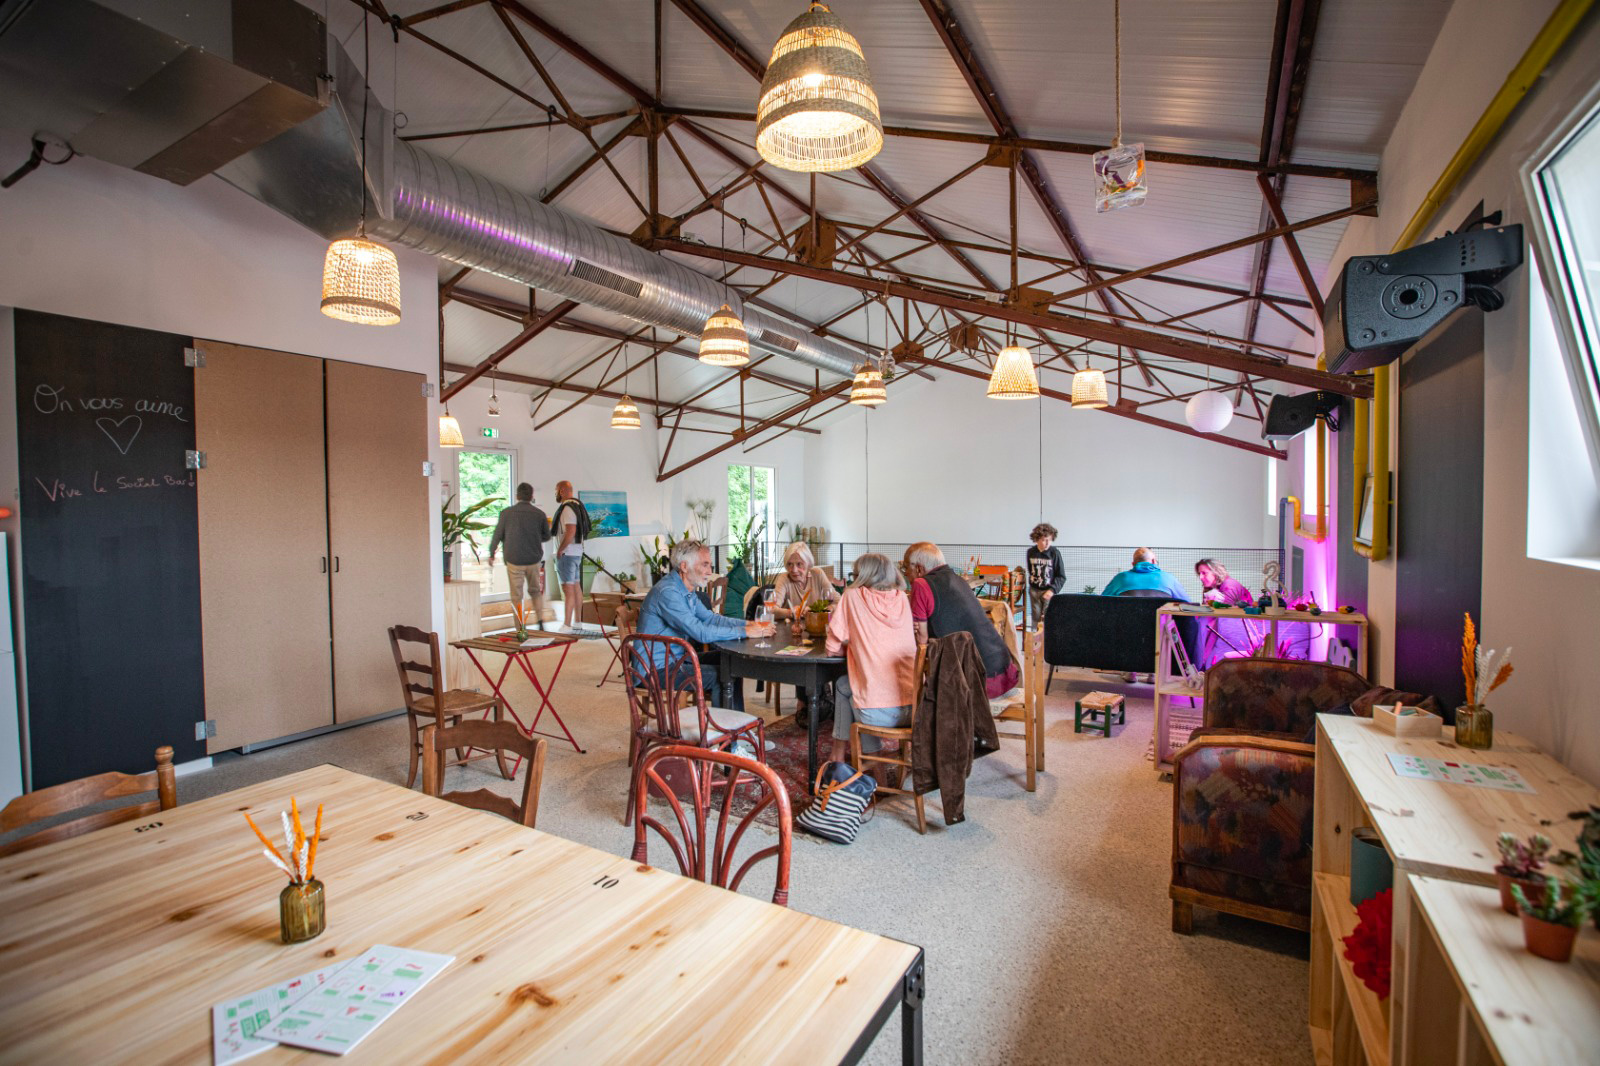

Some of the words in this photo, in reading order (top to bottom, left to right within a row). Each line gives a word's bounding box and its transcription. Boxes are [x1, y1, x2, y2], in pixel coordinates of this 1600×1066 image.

[34, 383, 73, 414] On
[80, 397, 124, 410] vous
[134, 395, 189, 422] aime
[34, 476, 83, 502] Vive
